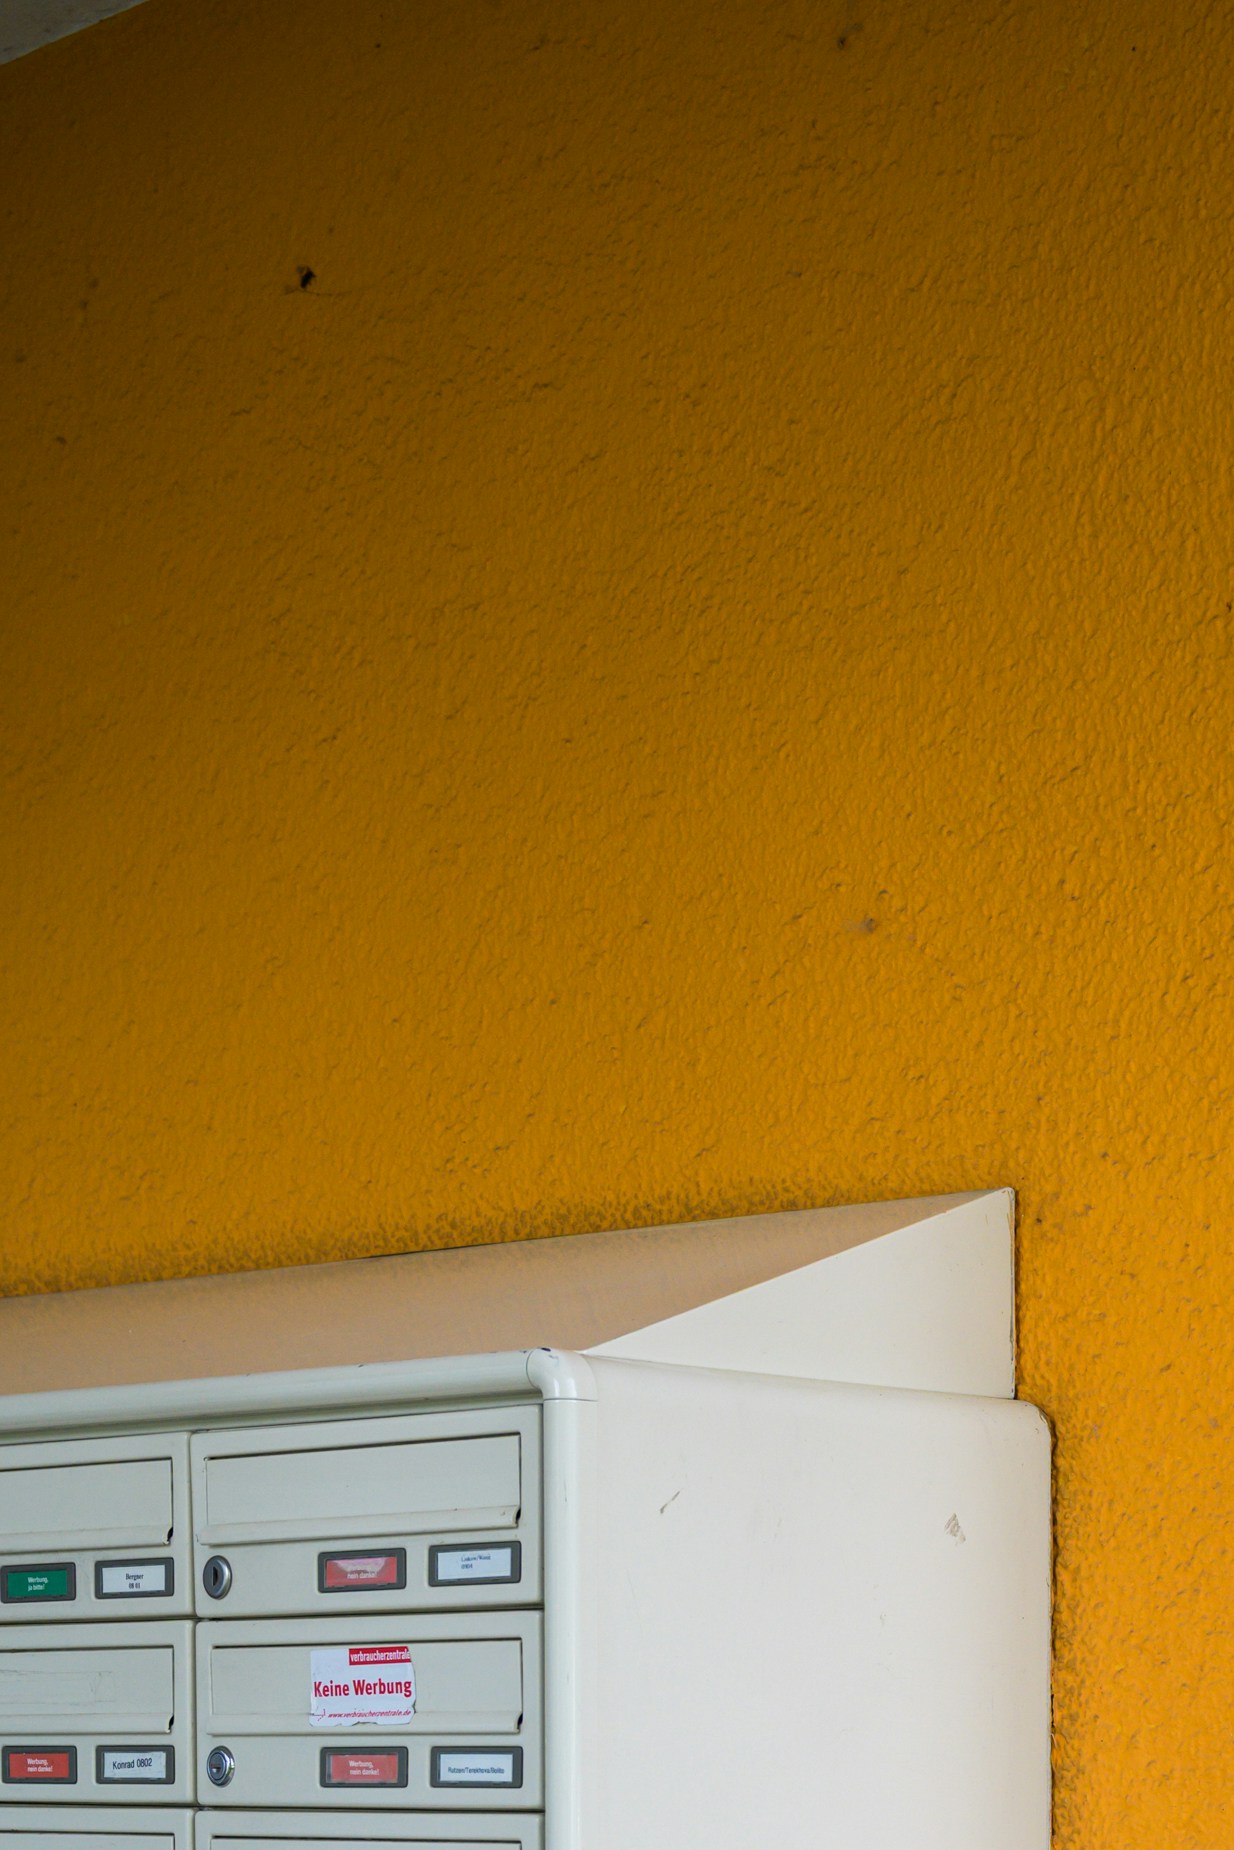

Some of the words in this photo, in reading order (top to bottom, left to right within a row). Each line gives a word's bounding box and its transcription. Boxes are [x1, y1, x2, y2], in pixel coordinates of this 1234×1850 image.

[126, 1573, 144, 1581] Bergner
[350, 1649, 410, 1662] verbraucherzentrale
[314, 1680, 350, 1697] Keine
[353, 1678, 412, 1698] Werbung
[27, 1758, 48, 1766] Werbung,
[113, 1760, 135, 1770] Konrad
[136, 1758, 153, 1768] 0802
[349, 1760, 374, 1769] Werbung,
[362, 1768, 380, 1776] danke!
